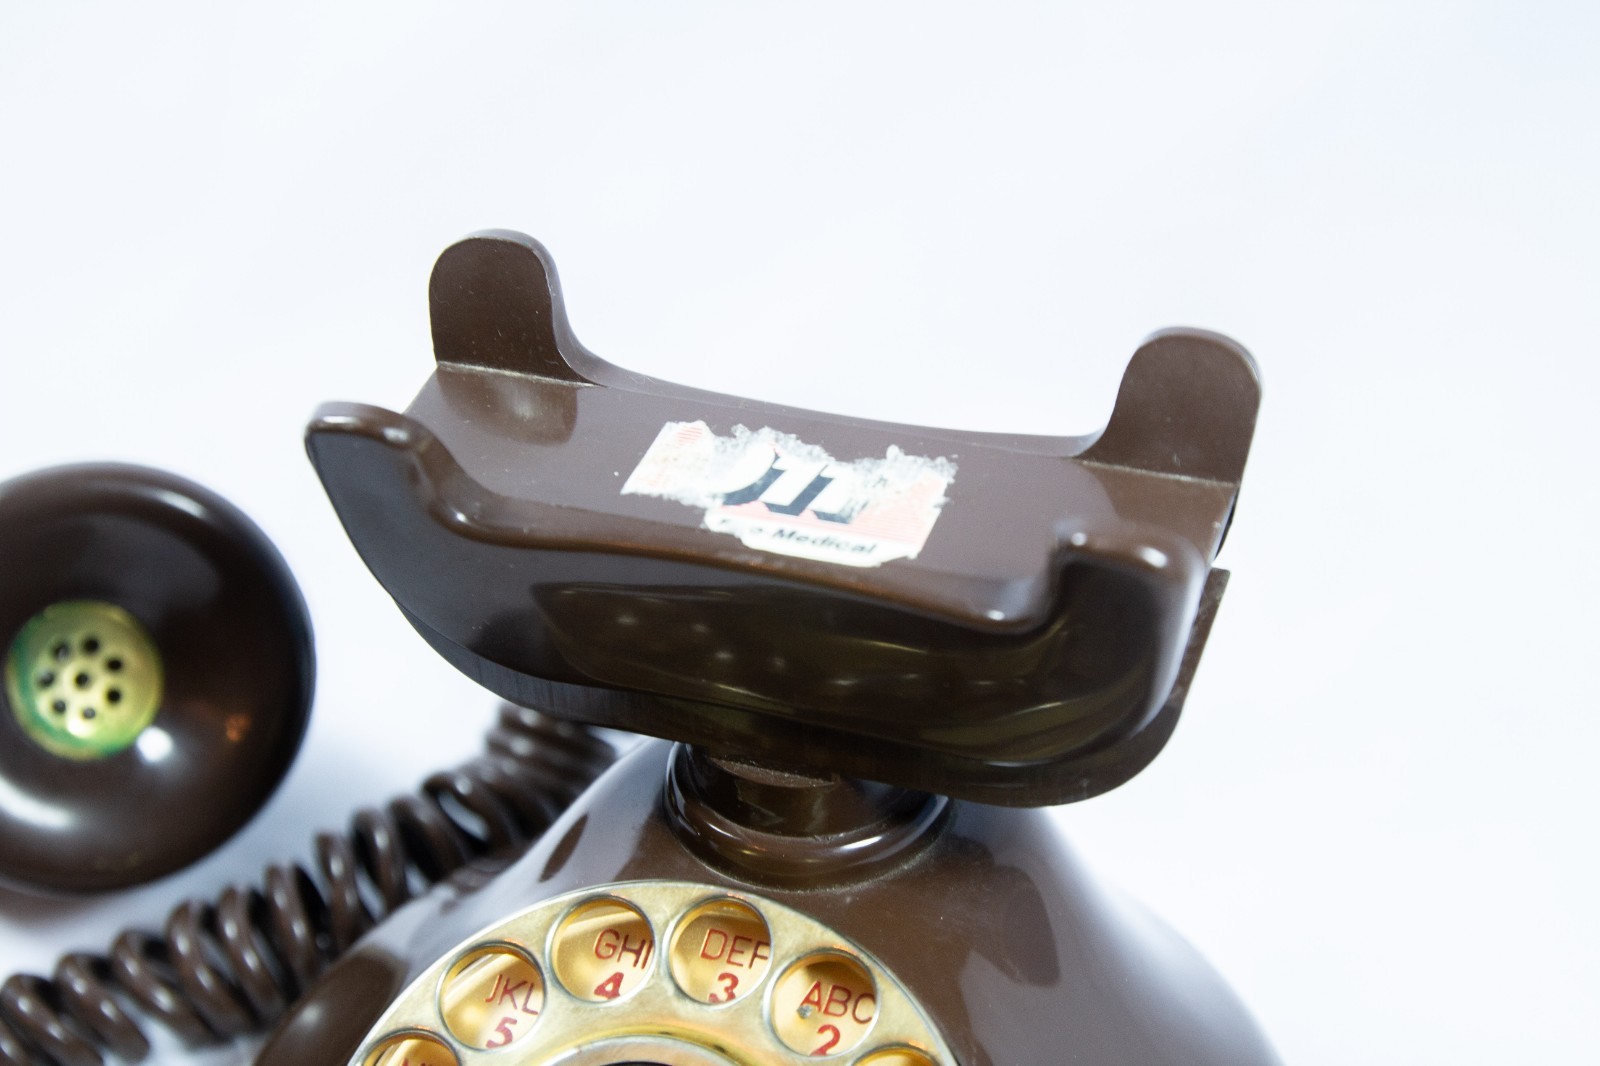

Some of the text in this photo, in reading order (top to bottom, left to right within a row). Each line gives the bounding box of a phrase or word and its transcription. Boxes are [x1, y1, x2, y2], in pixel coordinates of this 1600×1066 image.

[773, 528, 877, 554] Medical
[594, 928, 654, 969] GHI
[700, 928, 770, 969] DEF
[485, 974, 538, 1015] JKL
[594, 972, 625, 1000] 4
[708, 972, 739, 1004] 3
[800, 980, 876, 1024] ABC
[486, 1017, 517, 1049] 5
[809, 1024, 841, 1057] 2
